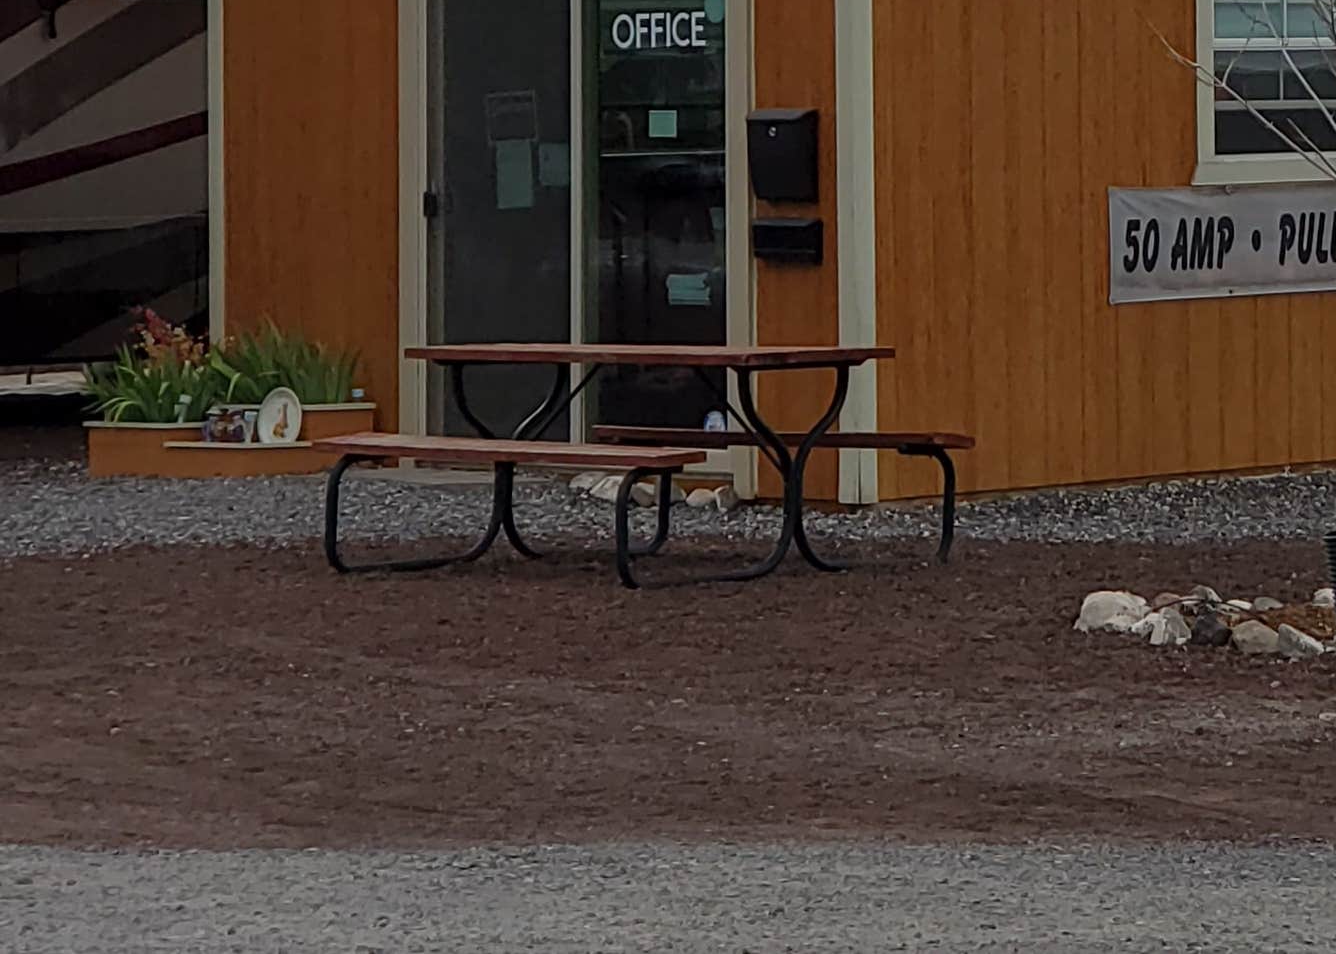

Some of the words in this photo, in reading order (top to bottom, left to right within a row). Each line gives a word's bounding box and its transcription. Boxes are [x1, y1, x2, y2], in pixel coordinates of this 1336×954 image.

[612, 11, 706, 48] OFFICE
[1123, 218, 1159, 272] 50
[1170, 216, 1234, 271] AMP
